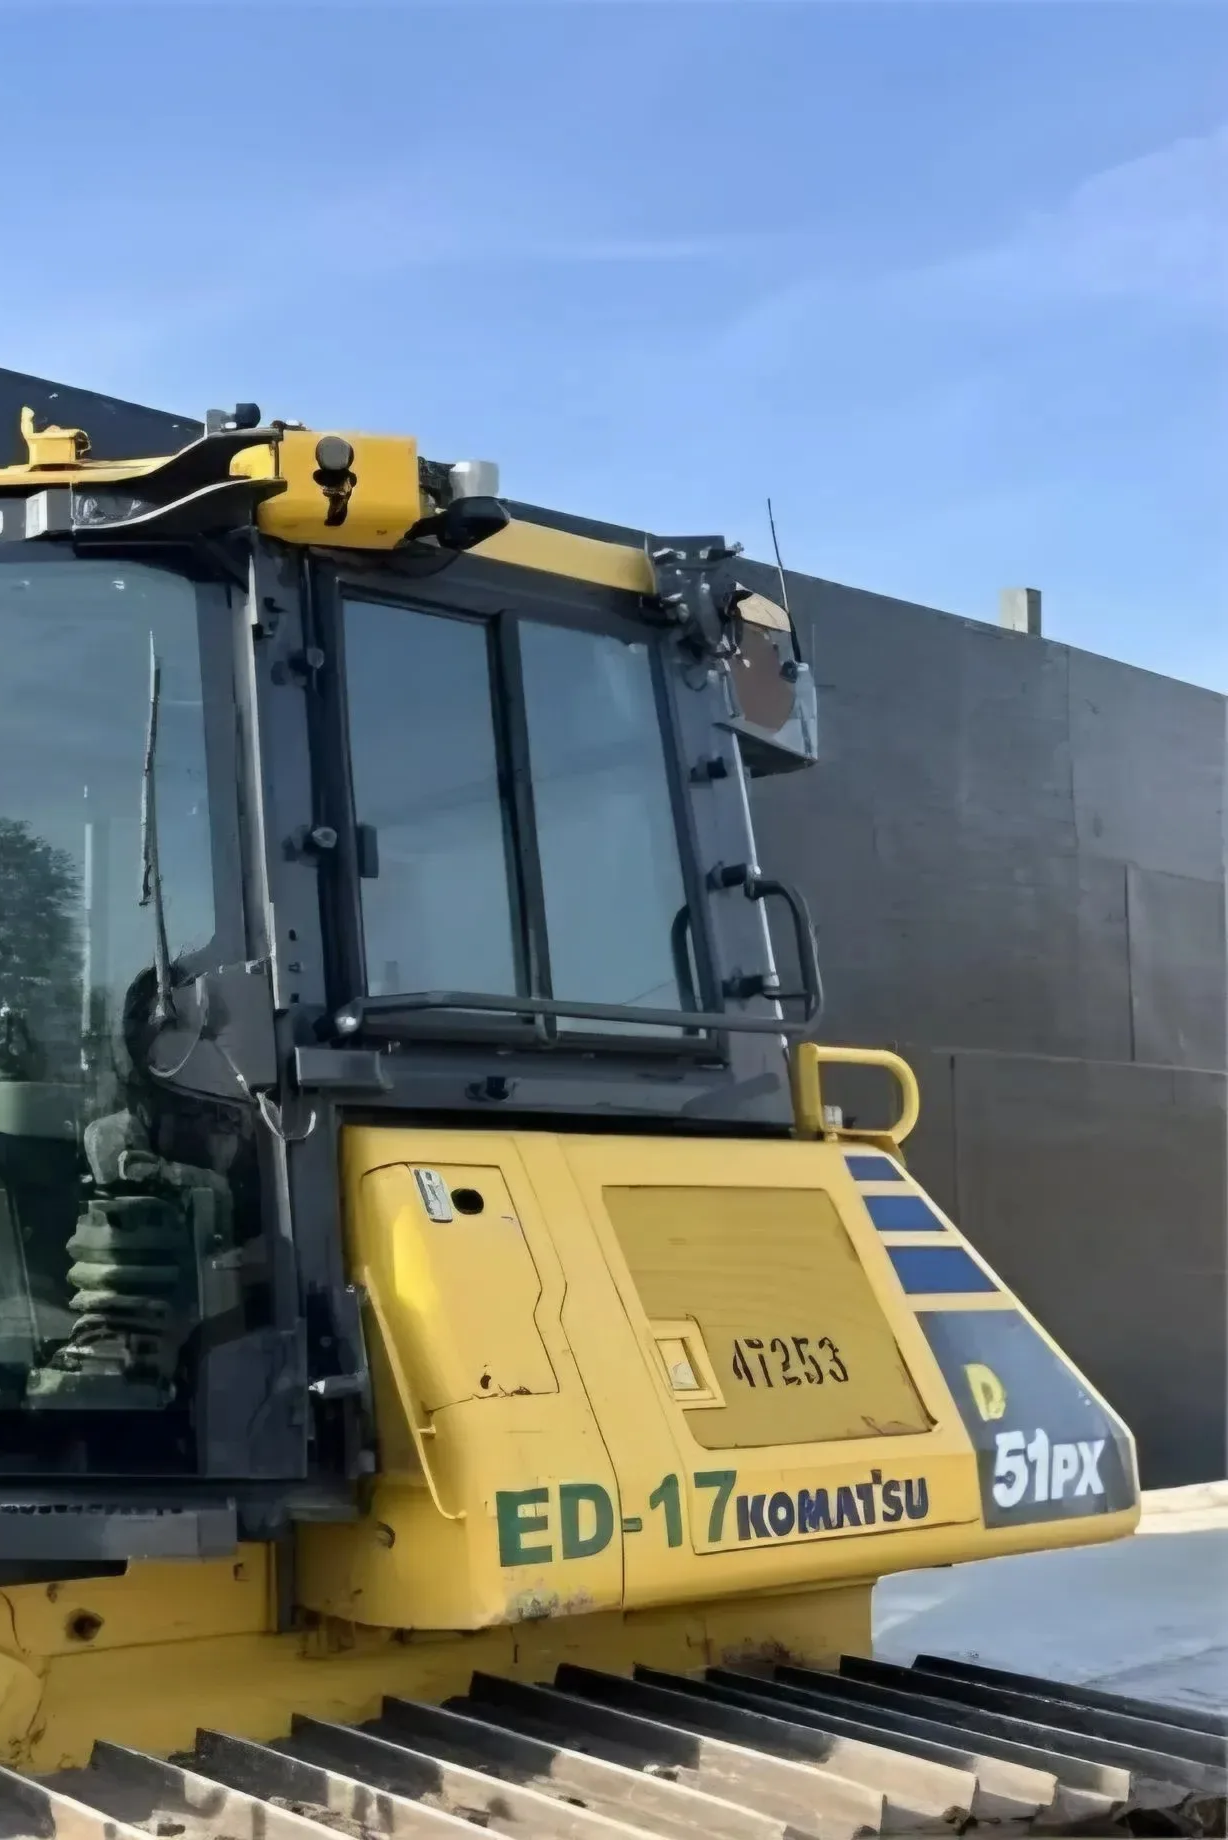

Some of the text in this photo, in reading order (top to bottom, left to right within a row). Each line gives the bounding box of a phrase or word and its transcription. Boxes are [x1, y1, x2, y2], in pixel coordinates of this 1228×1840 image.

[737, 1467, 929, 1541] KOMATSU
[992, 1427, 1106, 1508] 51PX
[495, 1469, 738, 1568] ED-17
